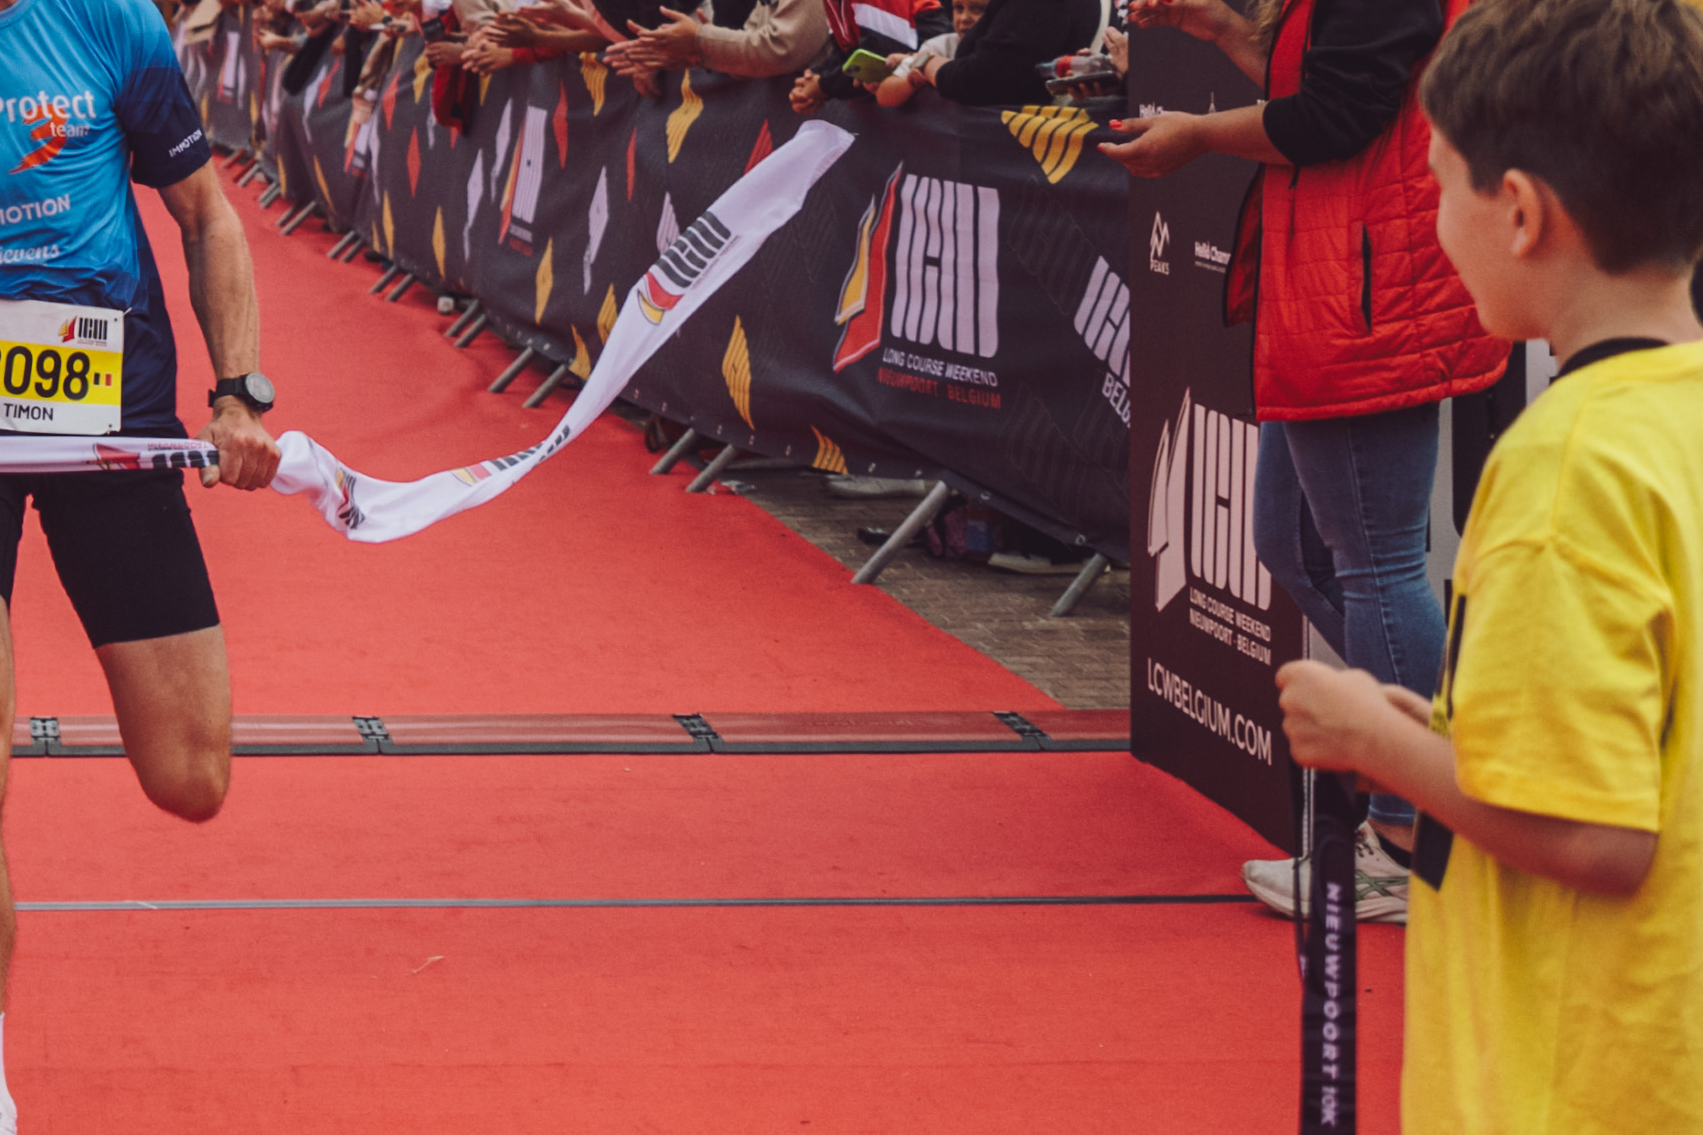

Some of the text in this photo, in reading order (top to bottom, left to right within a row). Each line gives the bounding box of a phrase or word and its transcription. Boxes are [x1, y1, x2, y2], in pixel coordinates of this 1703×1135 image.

[49, 121, 91, 138] team
[876, 366, 1002, 410] NIEUWPOORT BELGIUM
[882, 346, 998, 388] LONG COURSE WEEKEND
[3, 402, 54, 421] TIMON
[1189, 586, 1272, 642] LONG COURSE WEEKEND
[1189, 607, 1272, 666] NIEUWPOORT BELGIUM
[1147, 657, 1273, 766] LCWBELGIUM.COM
[1320, 881, 1343, 1127] NIEUWPOORT 10K
